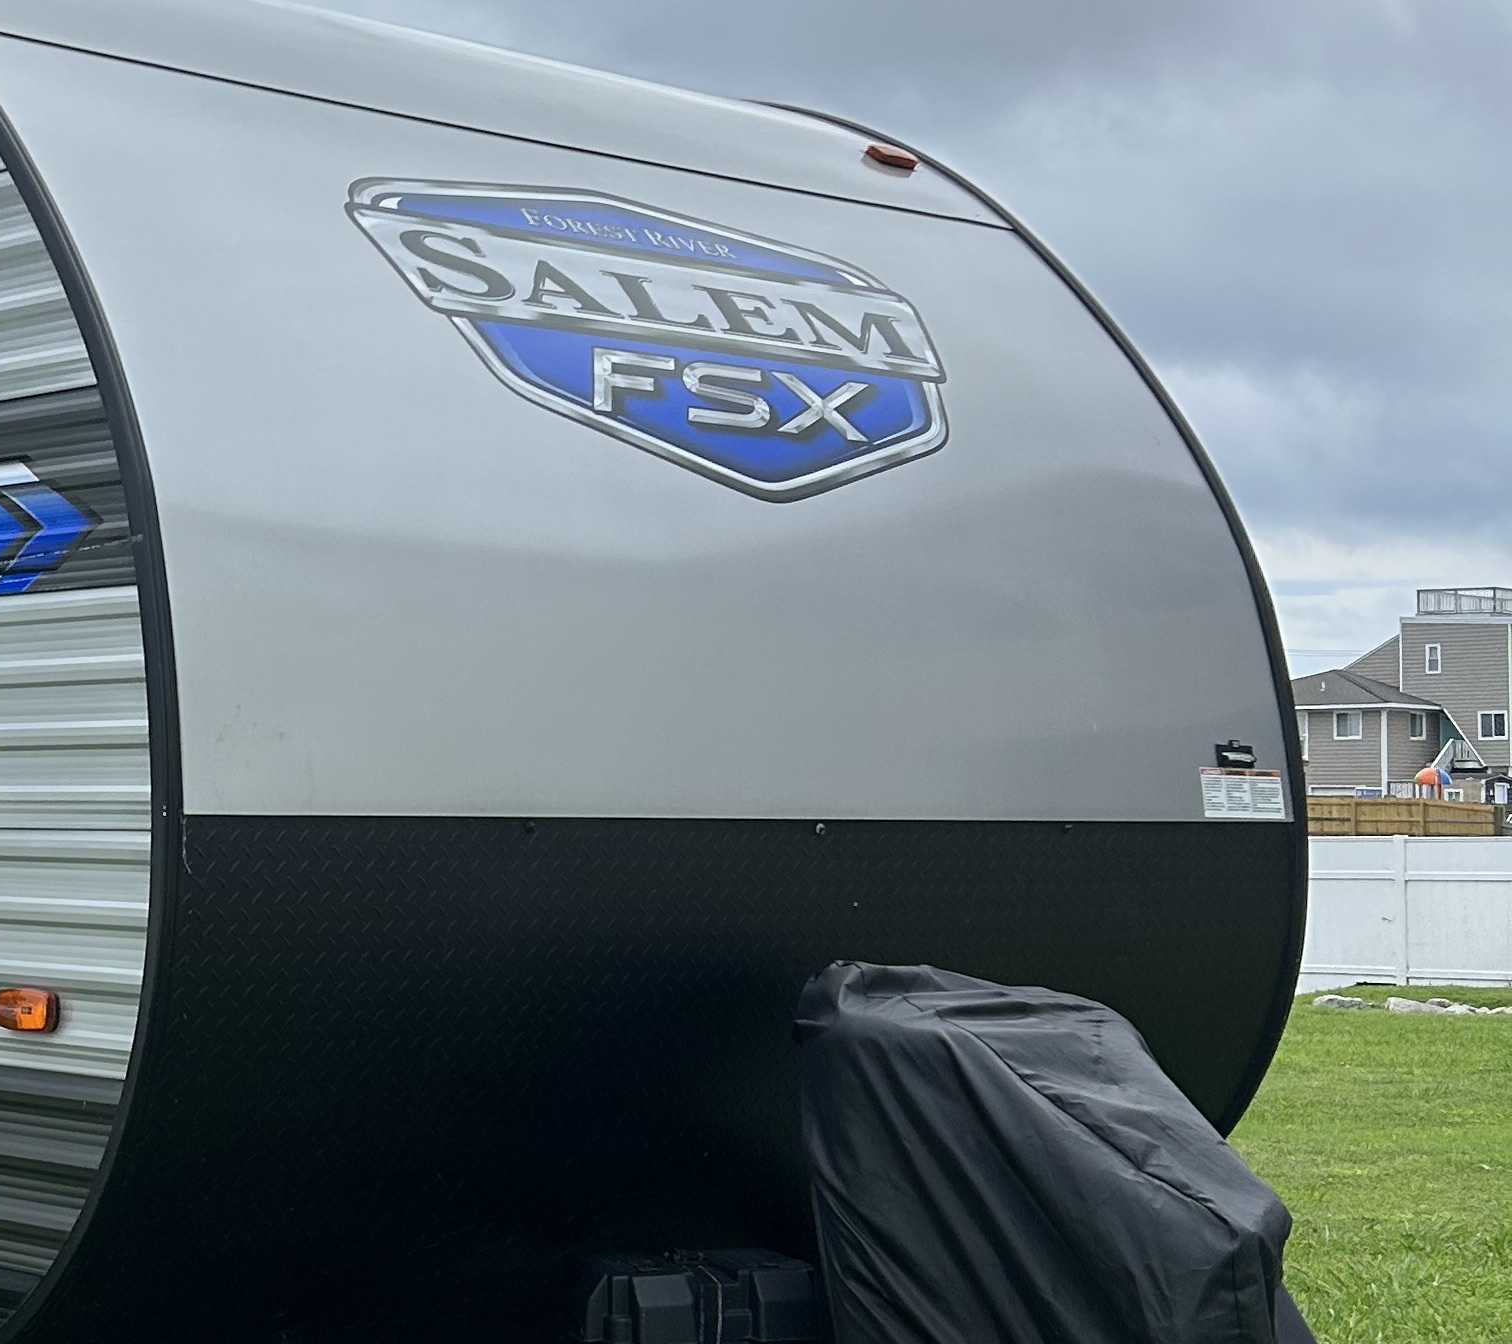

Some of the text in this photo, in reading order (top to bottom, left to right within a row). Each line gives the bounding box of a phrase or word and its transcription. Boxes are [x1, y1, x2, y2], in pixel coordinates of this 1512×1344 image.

[520, 207, 738, 259] FOREST RIVER
[399, 229, 928, 363] SALEM
[592, 347, 870, 444] FSX
